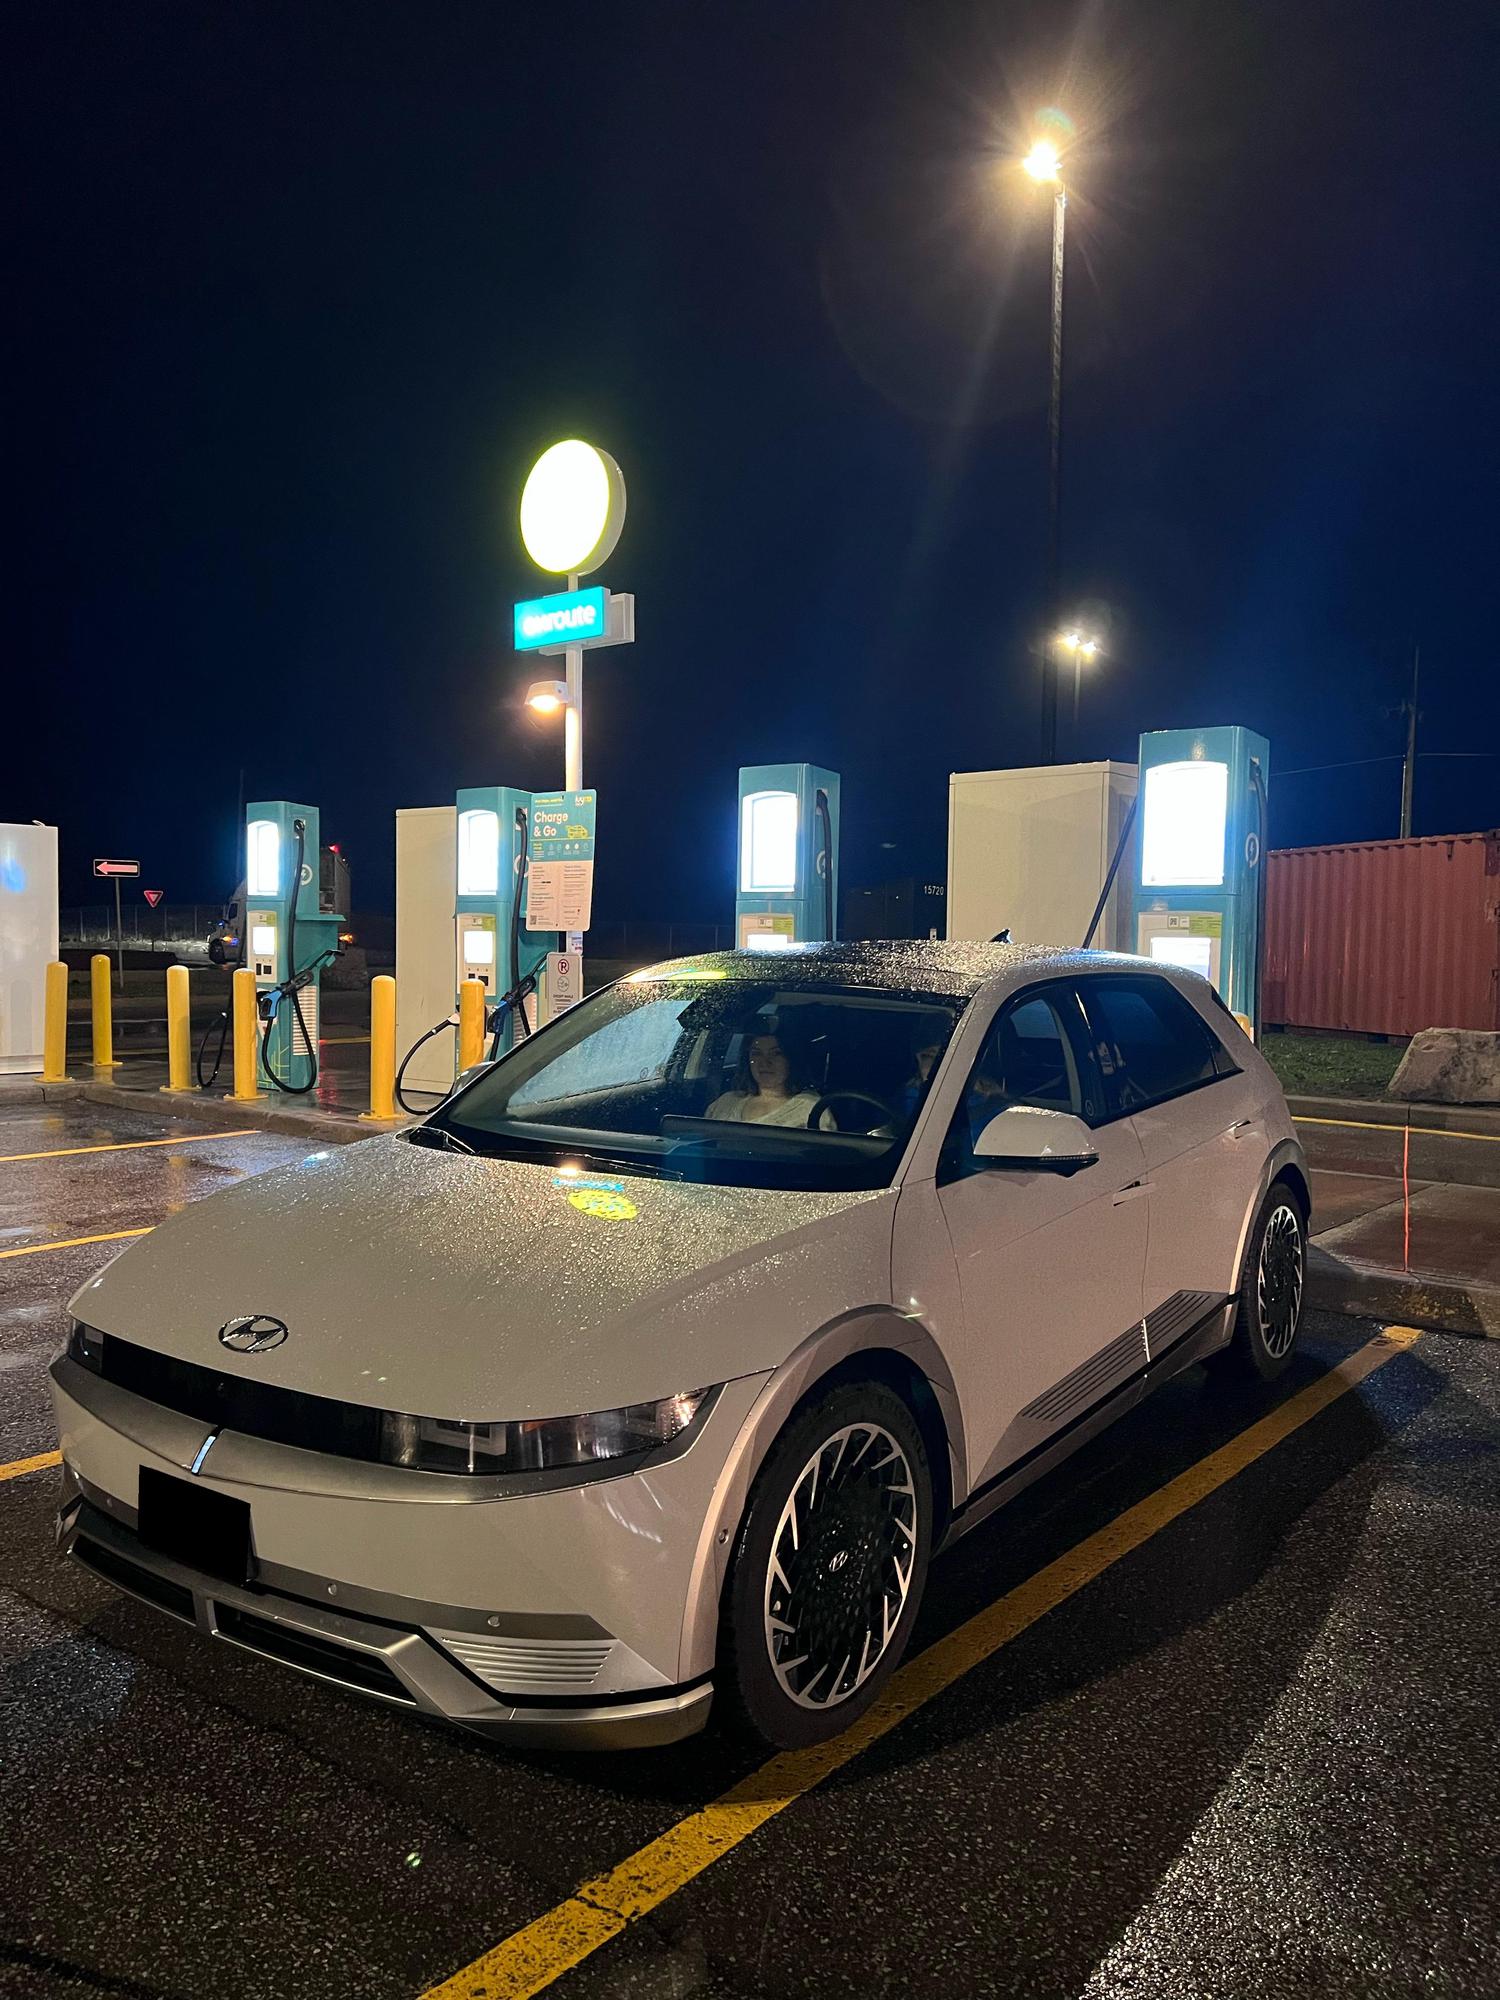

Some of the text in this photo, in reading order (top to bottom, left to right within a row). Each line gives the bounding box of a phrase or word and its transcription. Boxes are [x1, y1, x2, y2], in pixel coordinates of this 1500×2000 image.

[534, 811, 569, 825] Charge
[533, 825, 557, 837] & Go
[923, 885, 945, 896] 15720
